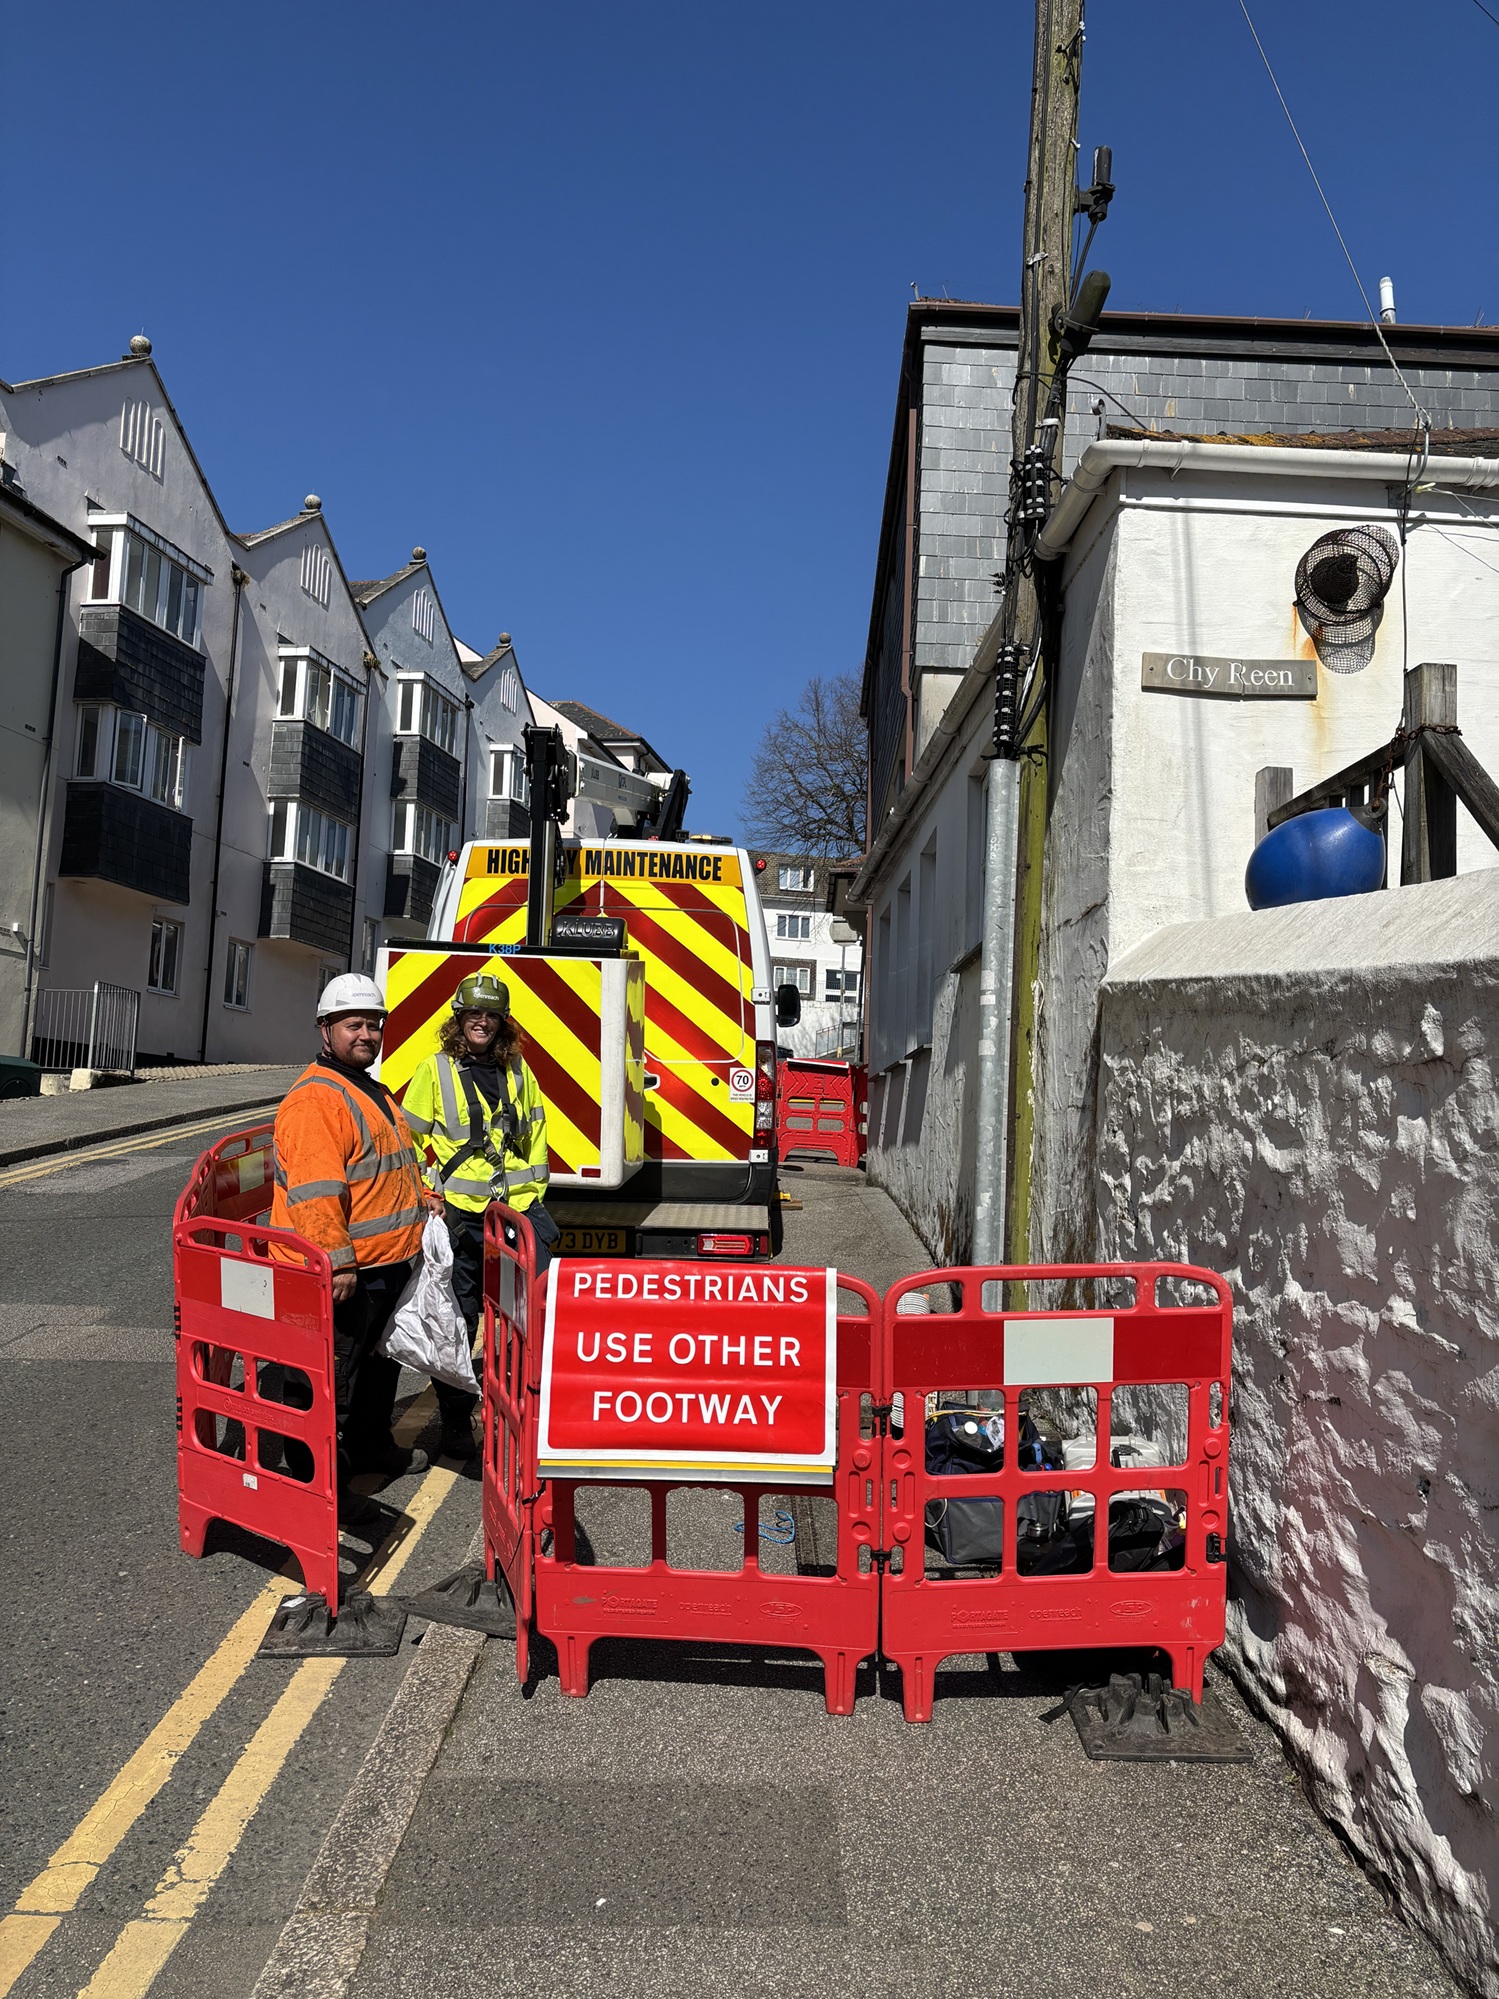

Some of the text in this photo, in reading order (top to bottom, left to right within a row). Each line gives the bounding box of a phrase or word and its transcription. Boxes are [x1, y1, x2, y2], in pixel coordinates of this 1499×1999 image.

[1167, 657, 1295, 688] Chy Reen
[487, 848, 722, 882] HIGHY MAINTENANCE
[557, 918, 618, 939] KLUBB
[488, 943, 521, 954] K38P
[736, 1074, 750, 1086] 70
[581, 1231, 619, 1250] DYB
[573, 1272, 809, 1303] PEDESTRIANS
[576, 1331, 801, 1367] USE OTHER
[592, 1390, 783, 1425] FOOTWAY
[679, 1601, 732, 1613] openreach
[1029, 1607, 1082, 1620] openreach
